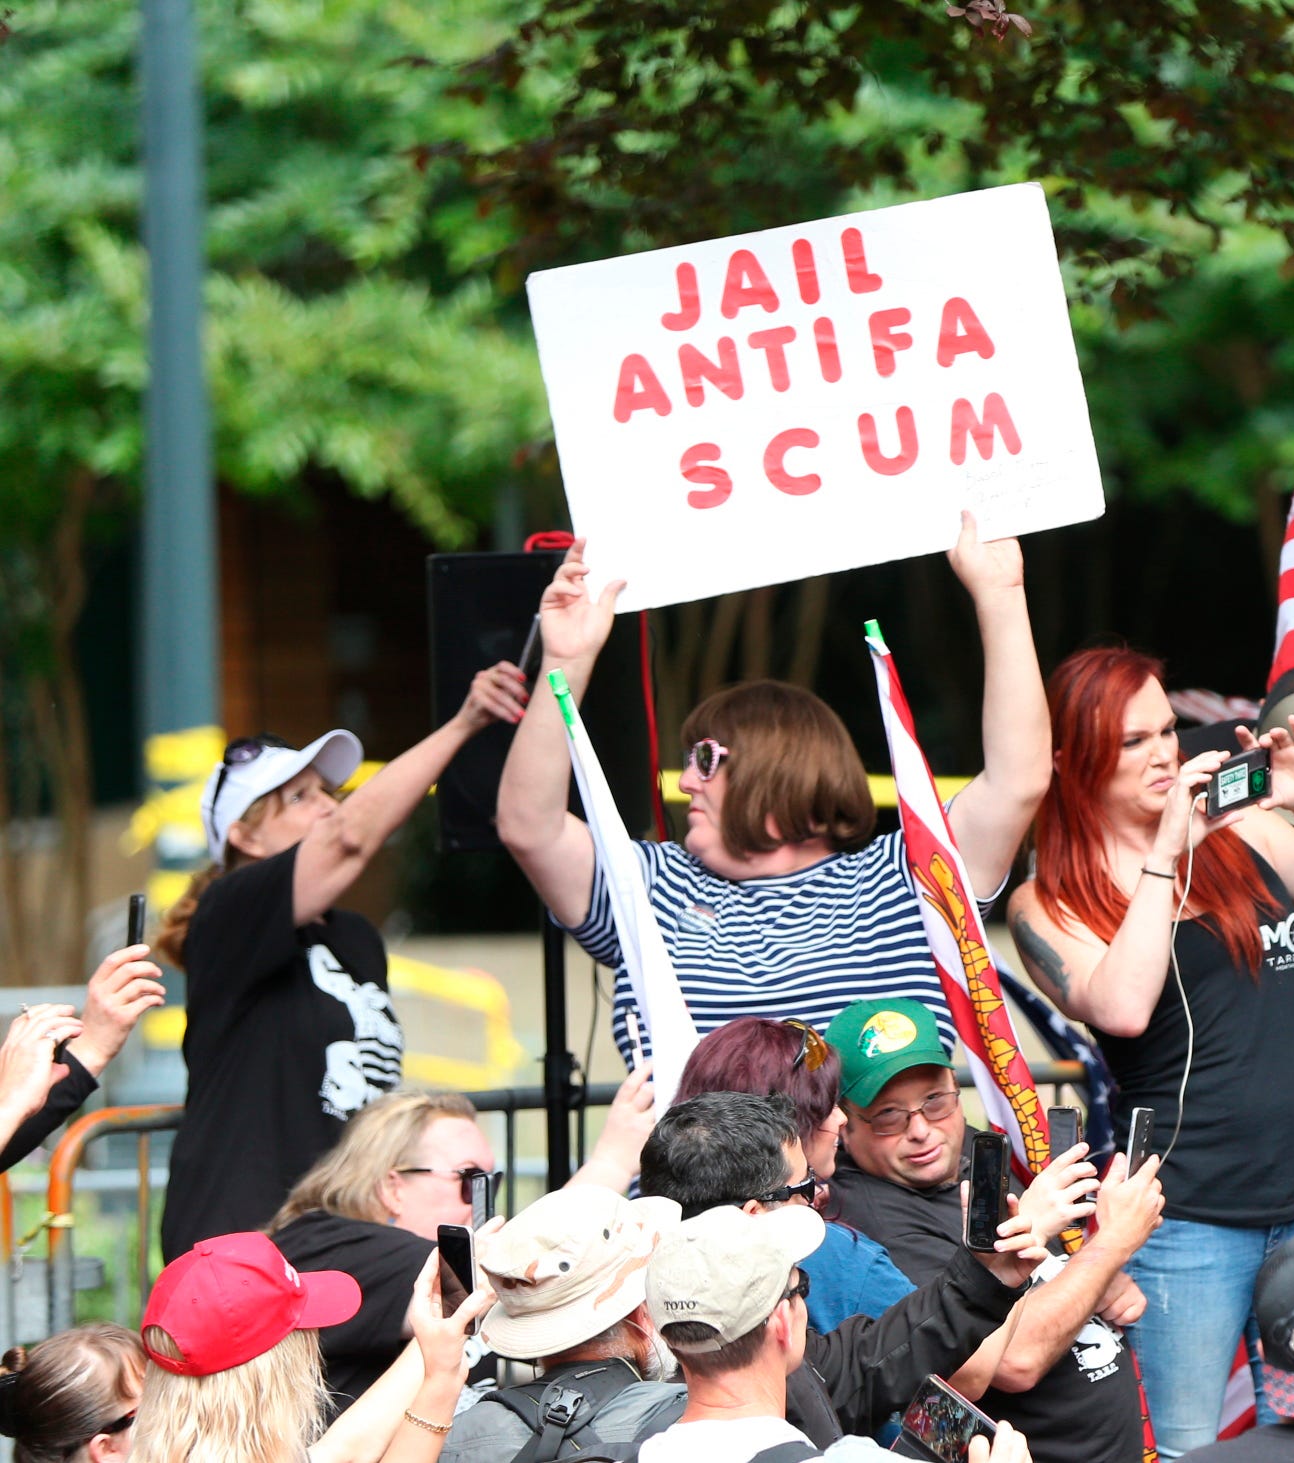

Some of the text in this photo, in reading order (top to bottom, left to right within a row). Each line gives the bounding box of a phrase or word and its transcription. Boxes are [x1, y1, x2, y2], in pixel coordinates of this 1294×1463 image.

[660, 226, 884, 332] JAIL
[612, 296, 996, 424] ANTIFA
[679, 391, 1023, 510] SCUM
[664, 1300, 697, 1311] TOTO
